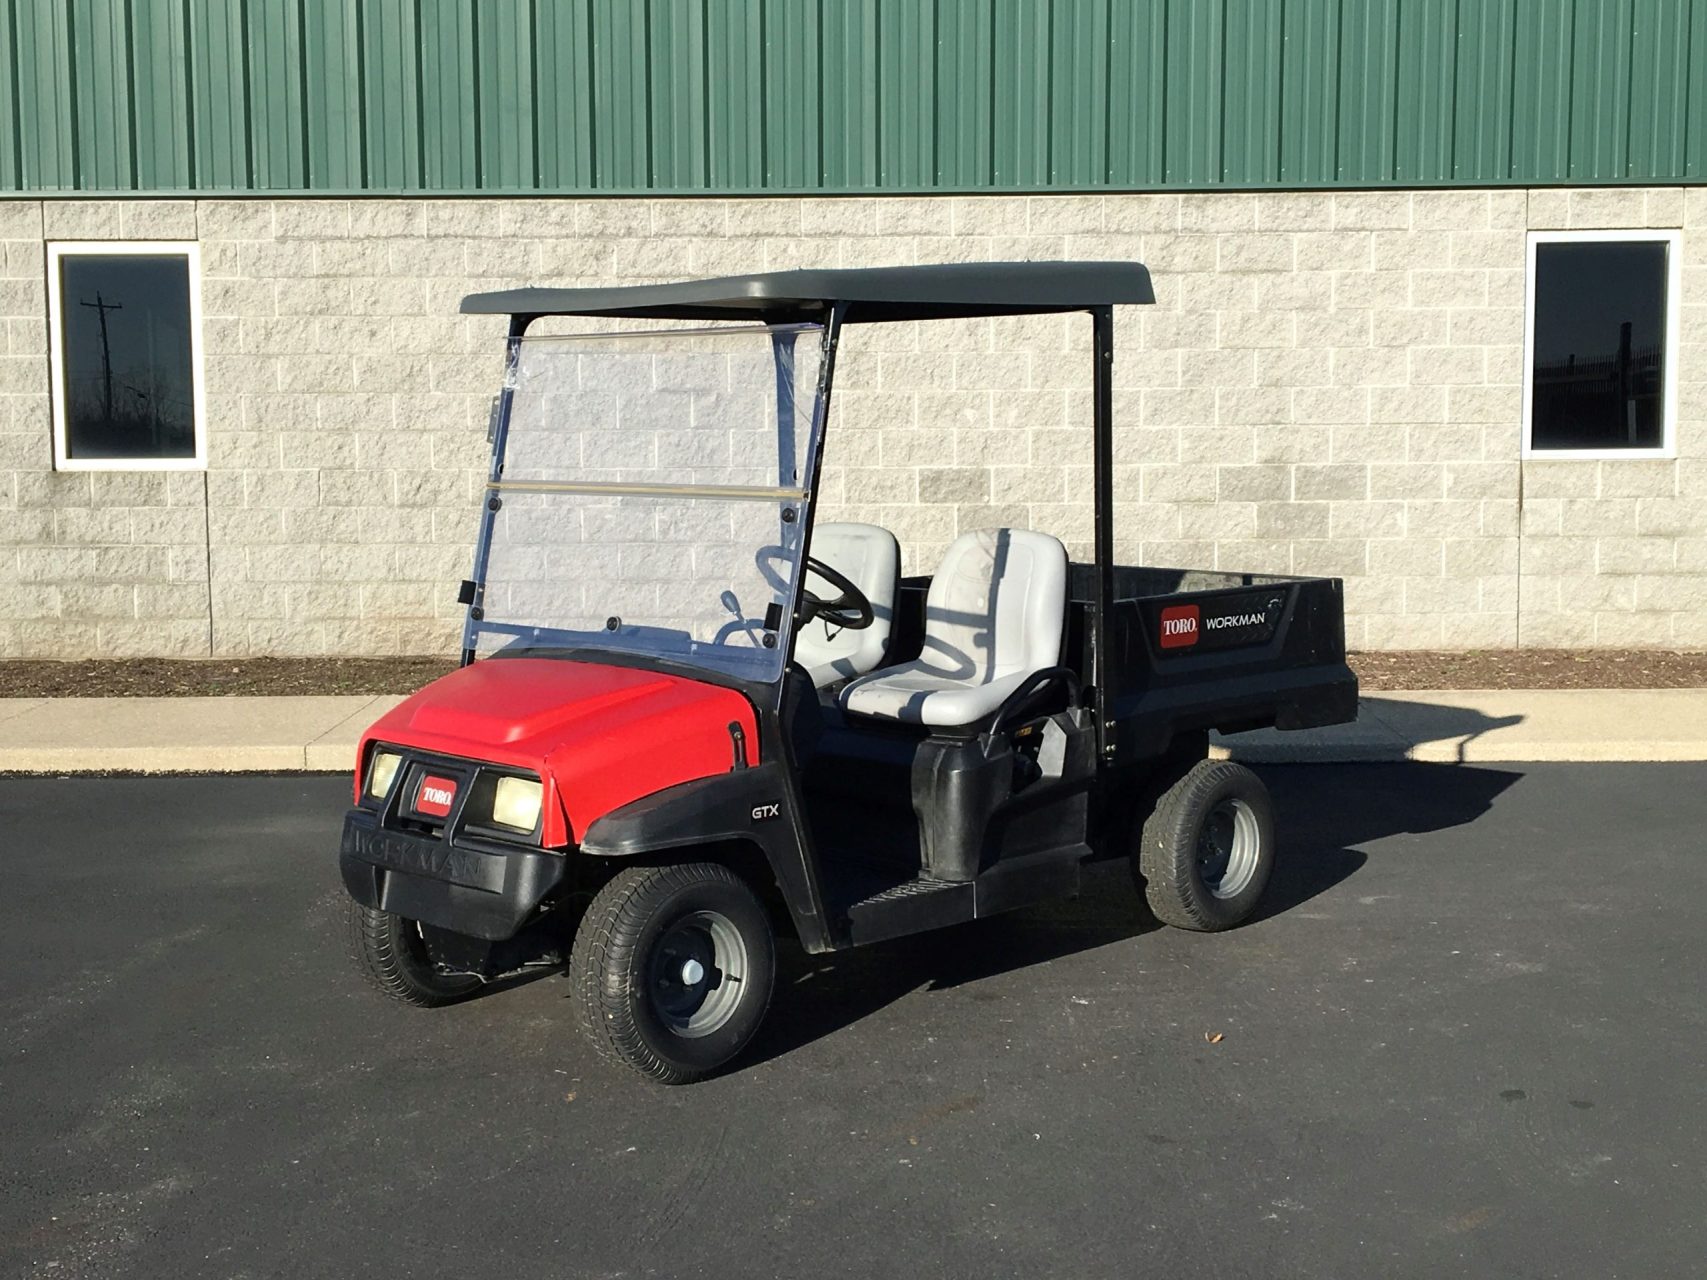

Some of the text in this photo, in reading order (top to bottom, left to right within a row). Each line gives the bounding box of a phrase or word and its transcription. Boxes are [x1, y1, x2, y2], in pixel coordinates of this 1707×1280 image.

[1164, 612, 1265, 635] TORO WORKMAN
[423, 787, 452, 806] TORO
[752, 803, 779, 819] GTX
